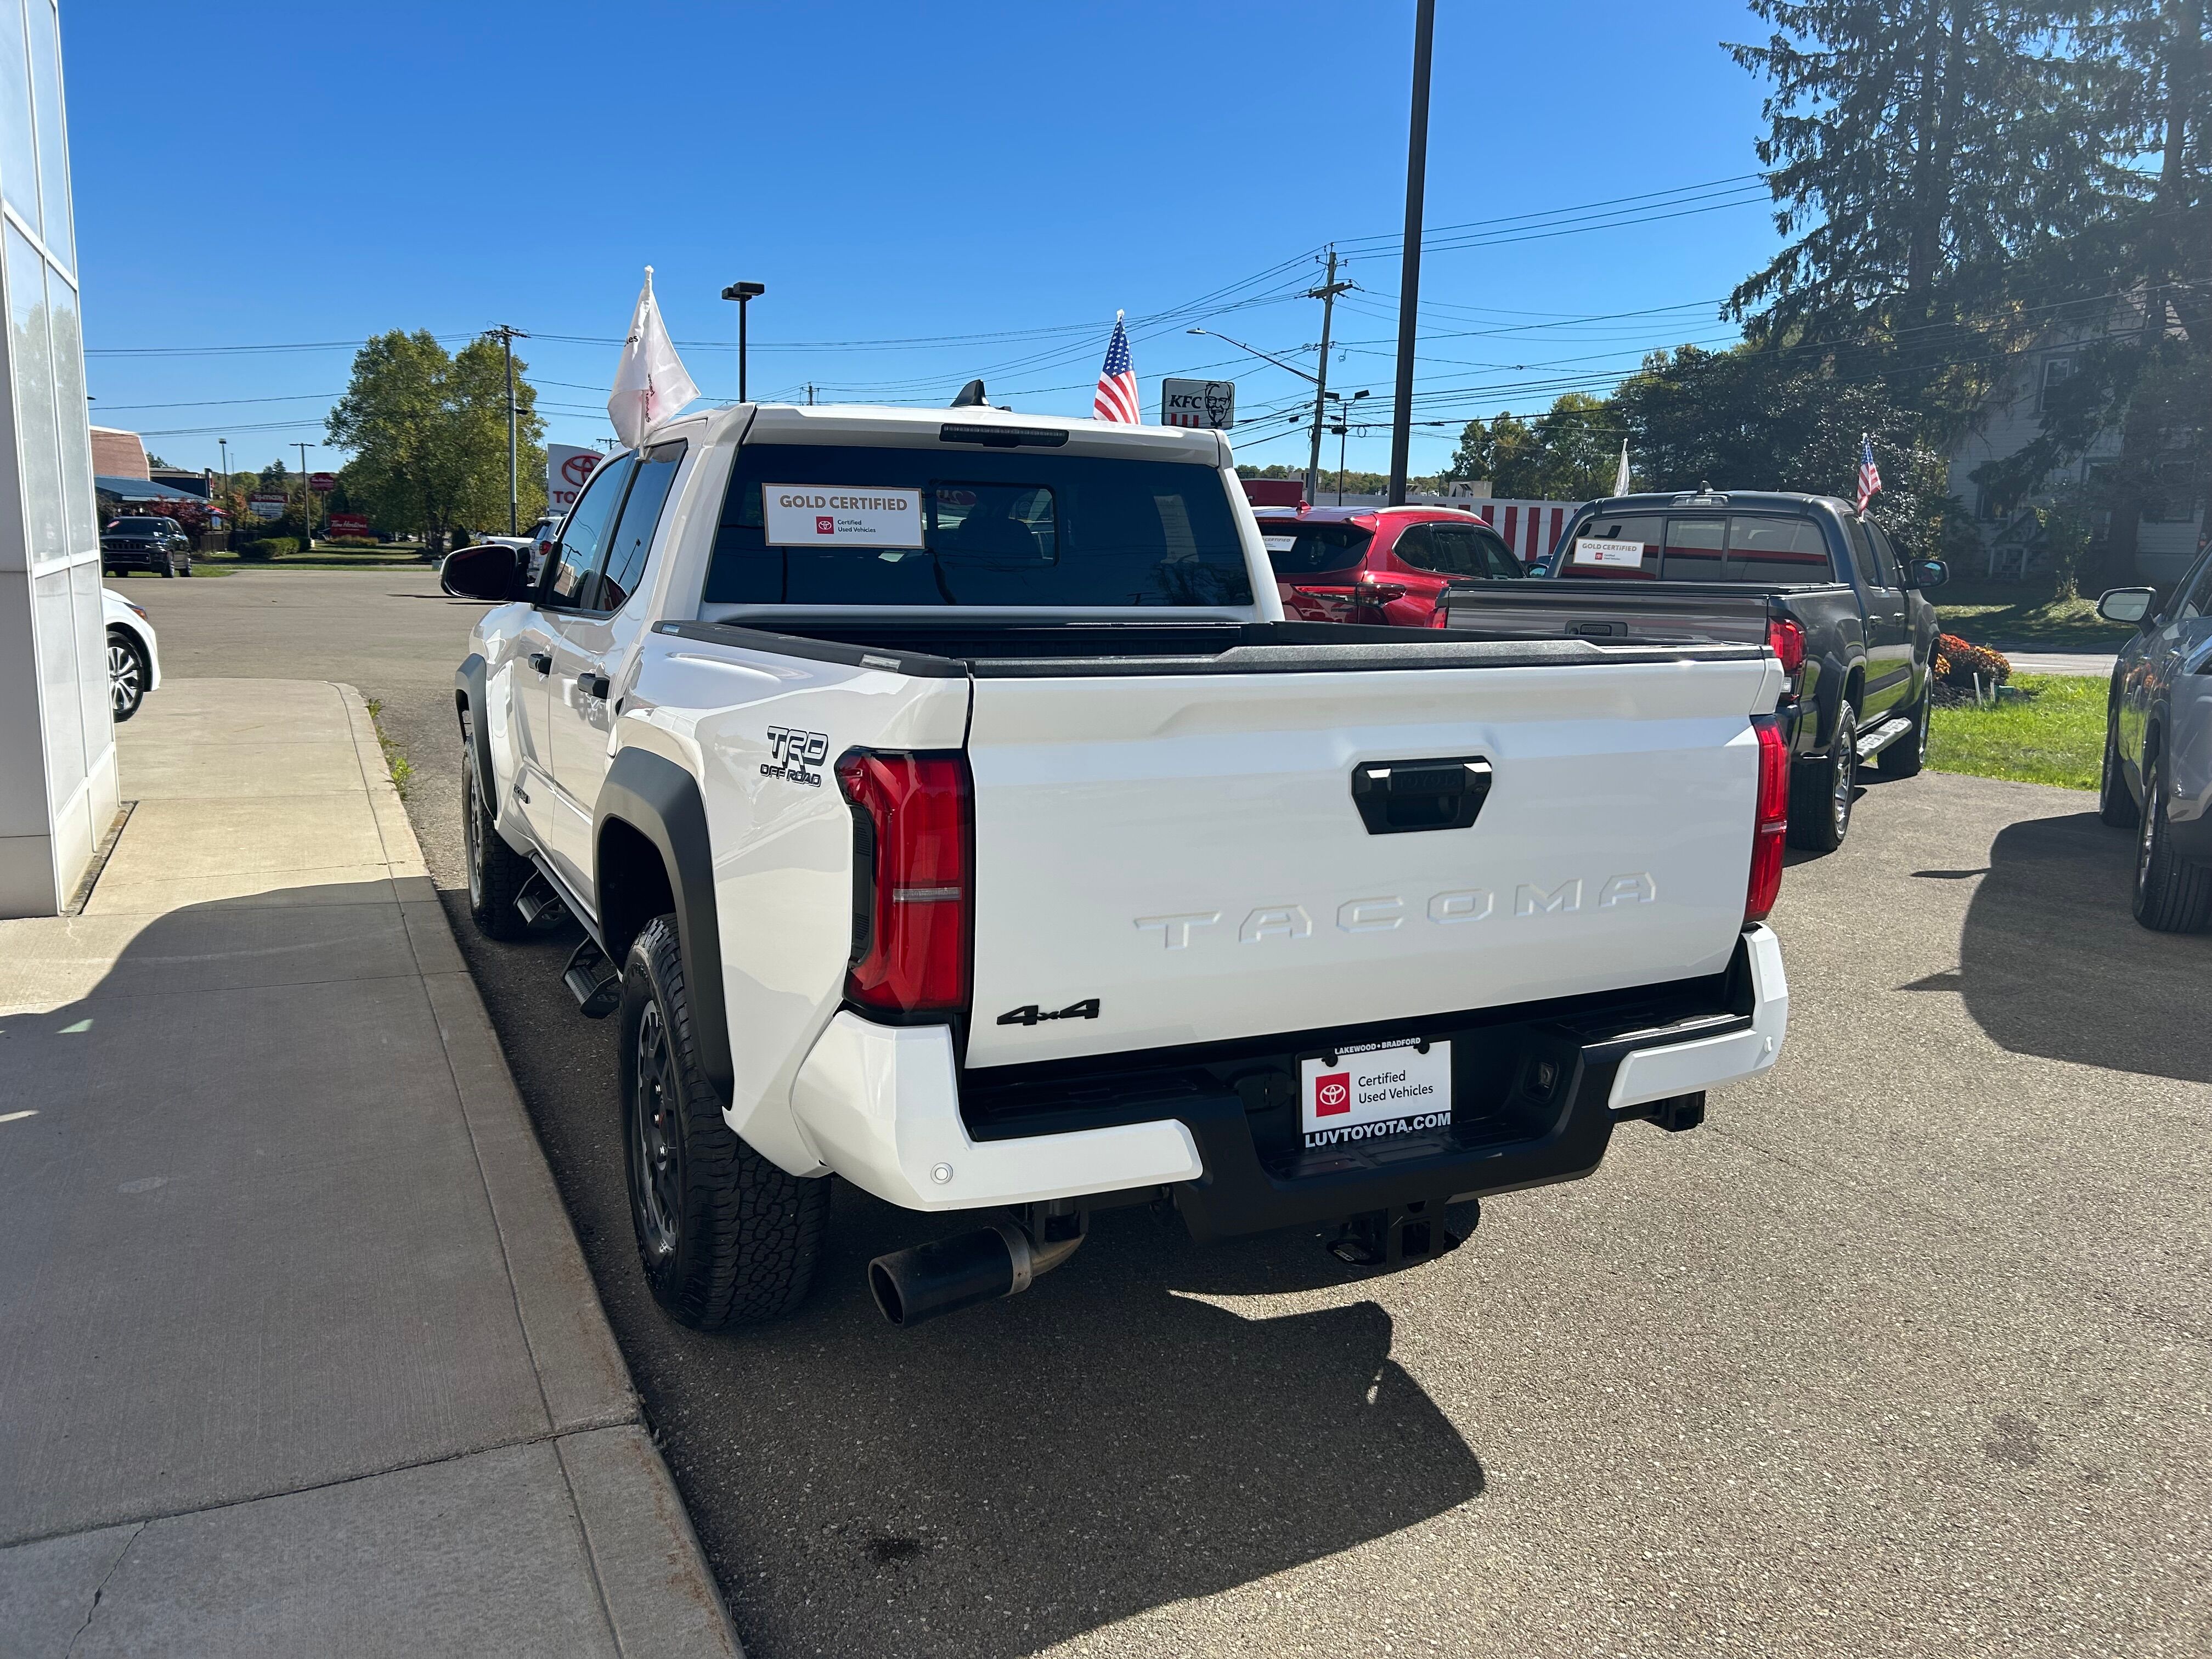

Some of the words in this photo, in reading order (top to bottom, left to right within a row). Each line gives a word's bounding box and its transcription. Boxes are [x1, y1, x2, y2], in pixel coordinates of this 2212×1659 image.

[1169, 394, 1202, 409] KFC
[553, 490, 579, 504] TO
[780, 495, 826, 508] GOLD
[829, 496, 907, 511] CERTIFIED
[767, 725, 829, 769] TRD
[760, 764, 786, 780] OFF
[786, 769, 822, 788] ROAD
[1133, 871, 1657, 950] TACOMA
[996, 998, 1100, 1026] 4x4
[1358, 1070, 1406, 1087] Certified
[1358, 1091, 1386, 1104] Used
[1389, 1084, 1434, 1099] Vehicles
[1305, 1111, 1451, 1148] LUVTOYOTA.COM
